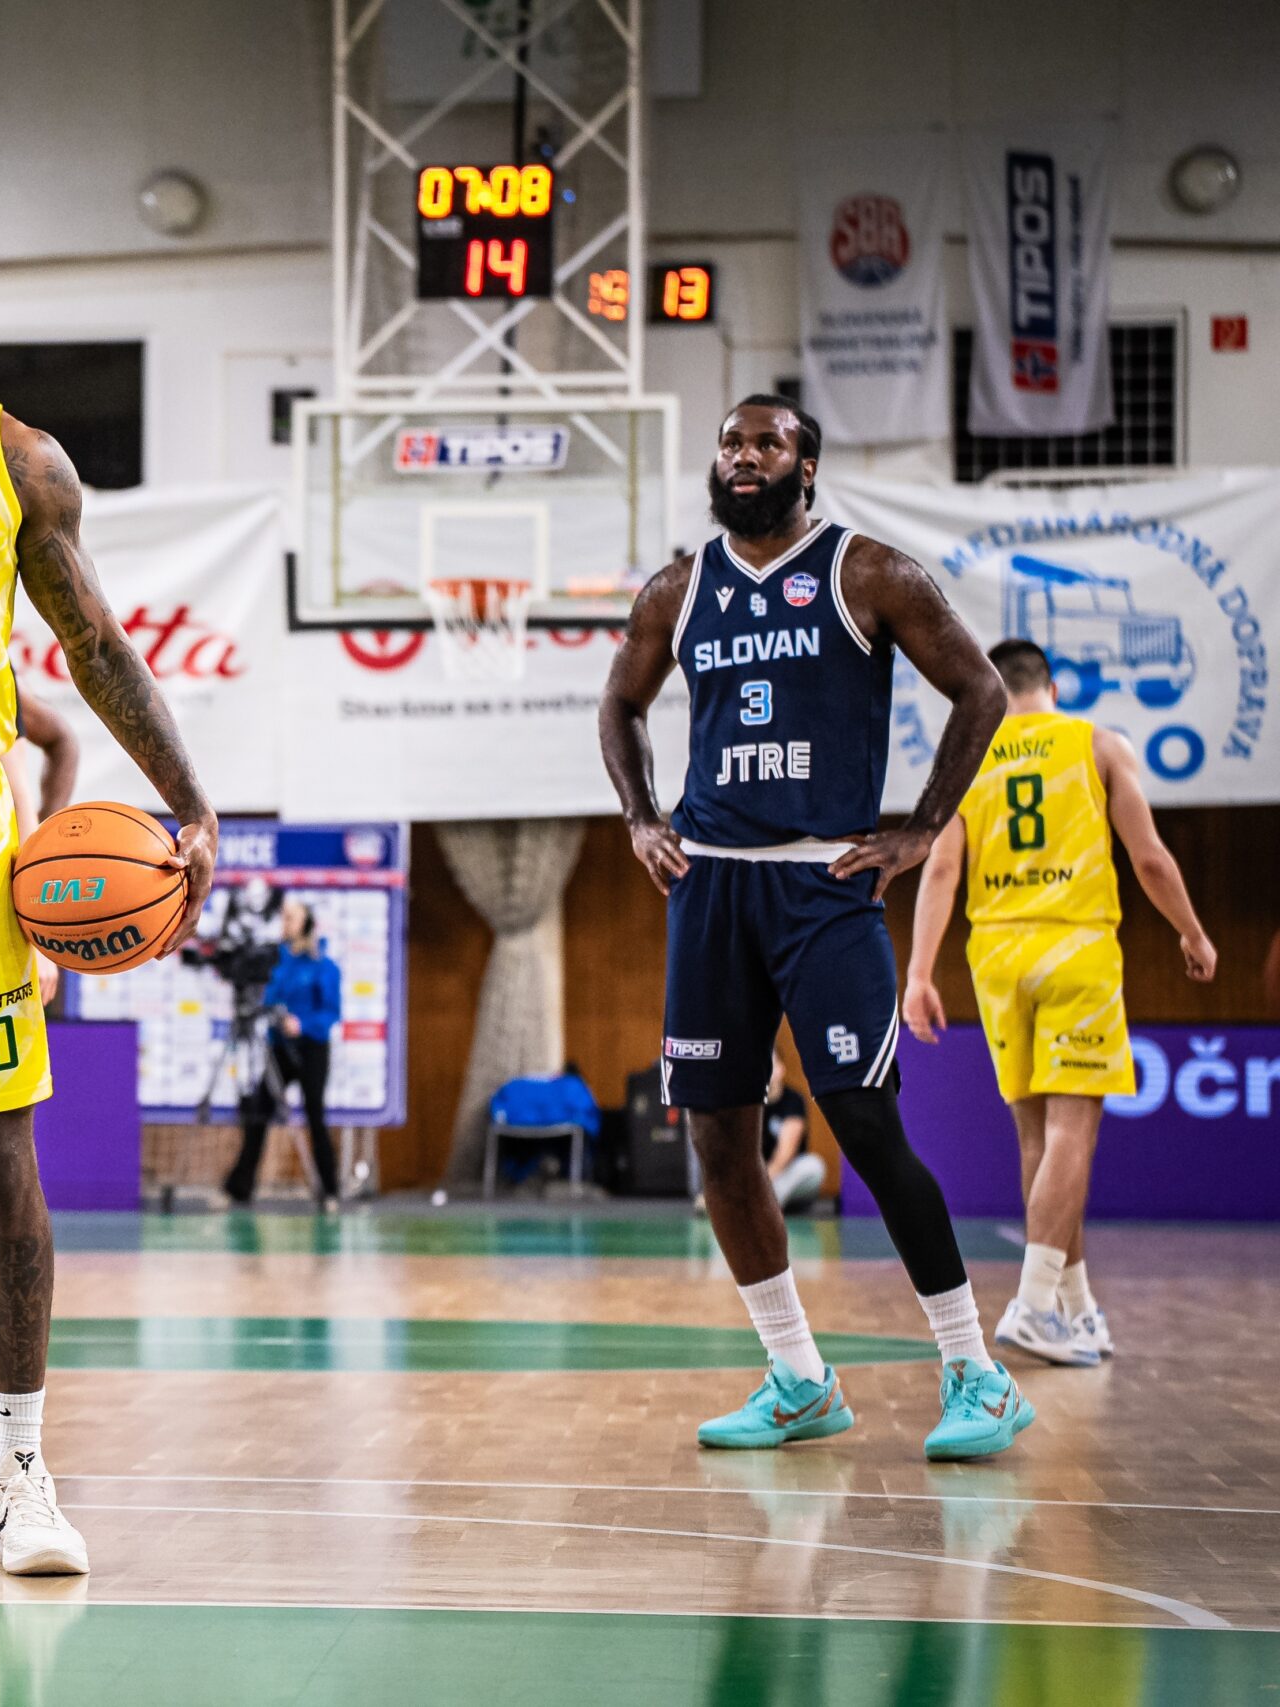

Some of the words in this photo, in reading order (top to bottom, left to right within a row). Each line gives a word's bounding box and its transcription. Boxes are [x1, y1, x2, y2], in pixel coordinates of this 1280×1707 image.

[418, 164, 553, 218] 07:08
[465, 239, 527, 296] 14
[1014, 166, 1051, 329] TIPOS
[663, 267, 710, 319] 13
[694, 627, 819, 673] SLOVAN
[740, 680, 772, 726] 3
[716, 741, 811, 786] JTRE
[1006, 774, 1046, 853] 8
[40, 877, 107, 905] EVO
[30, 925, 146, 961] Wilson
[671, 1042, 716, 1056] TIPOS
